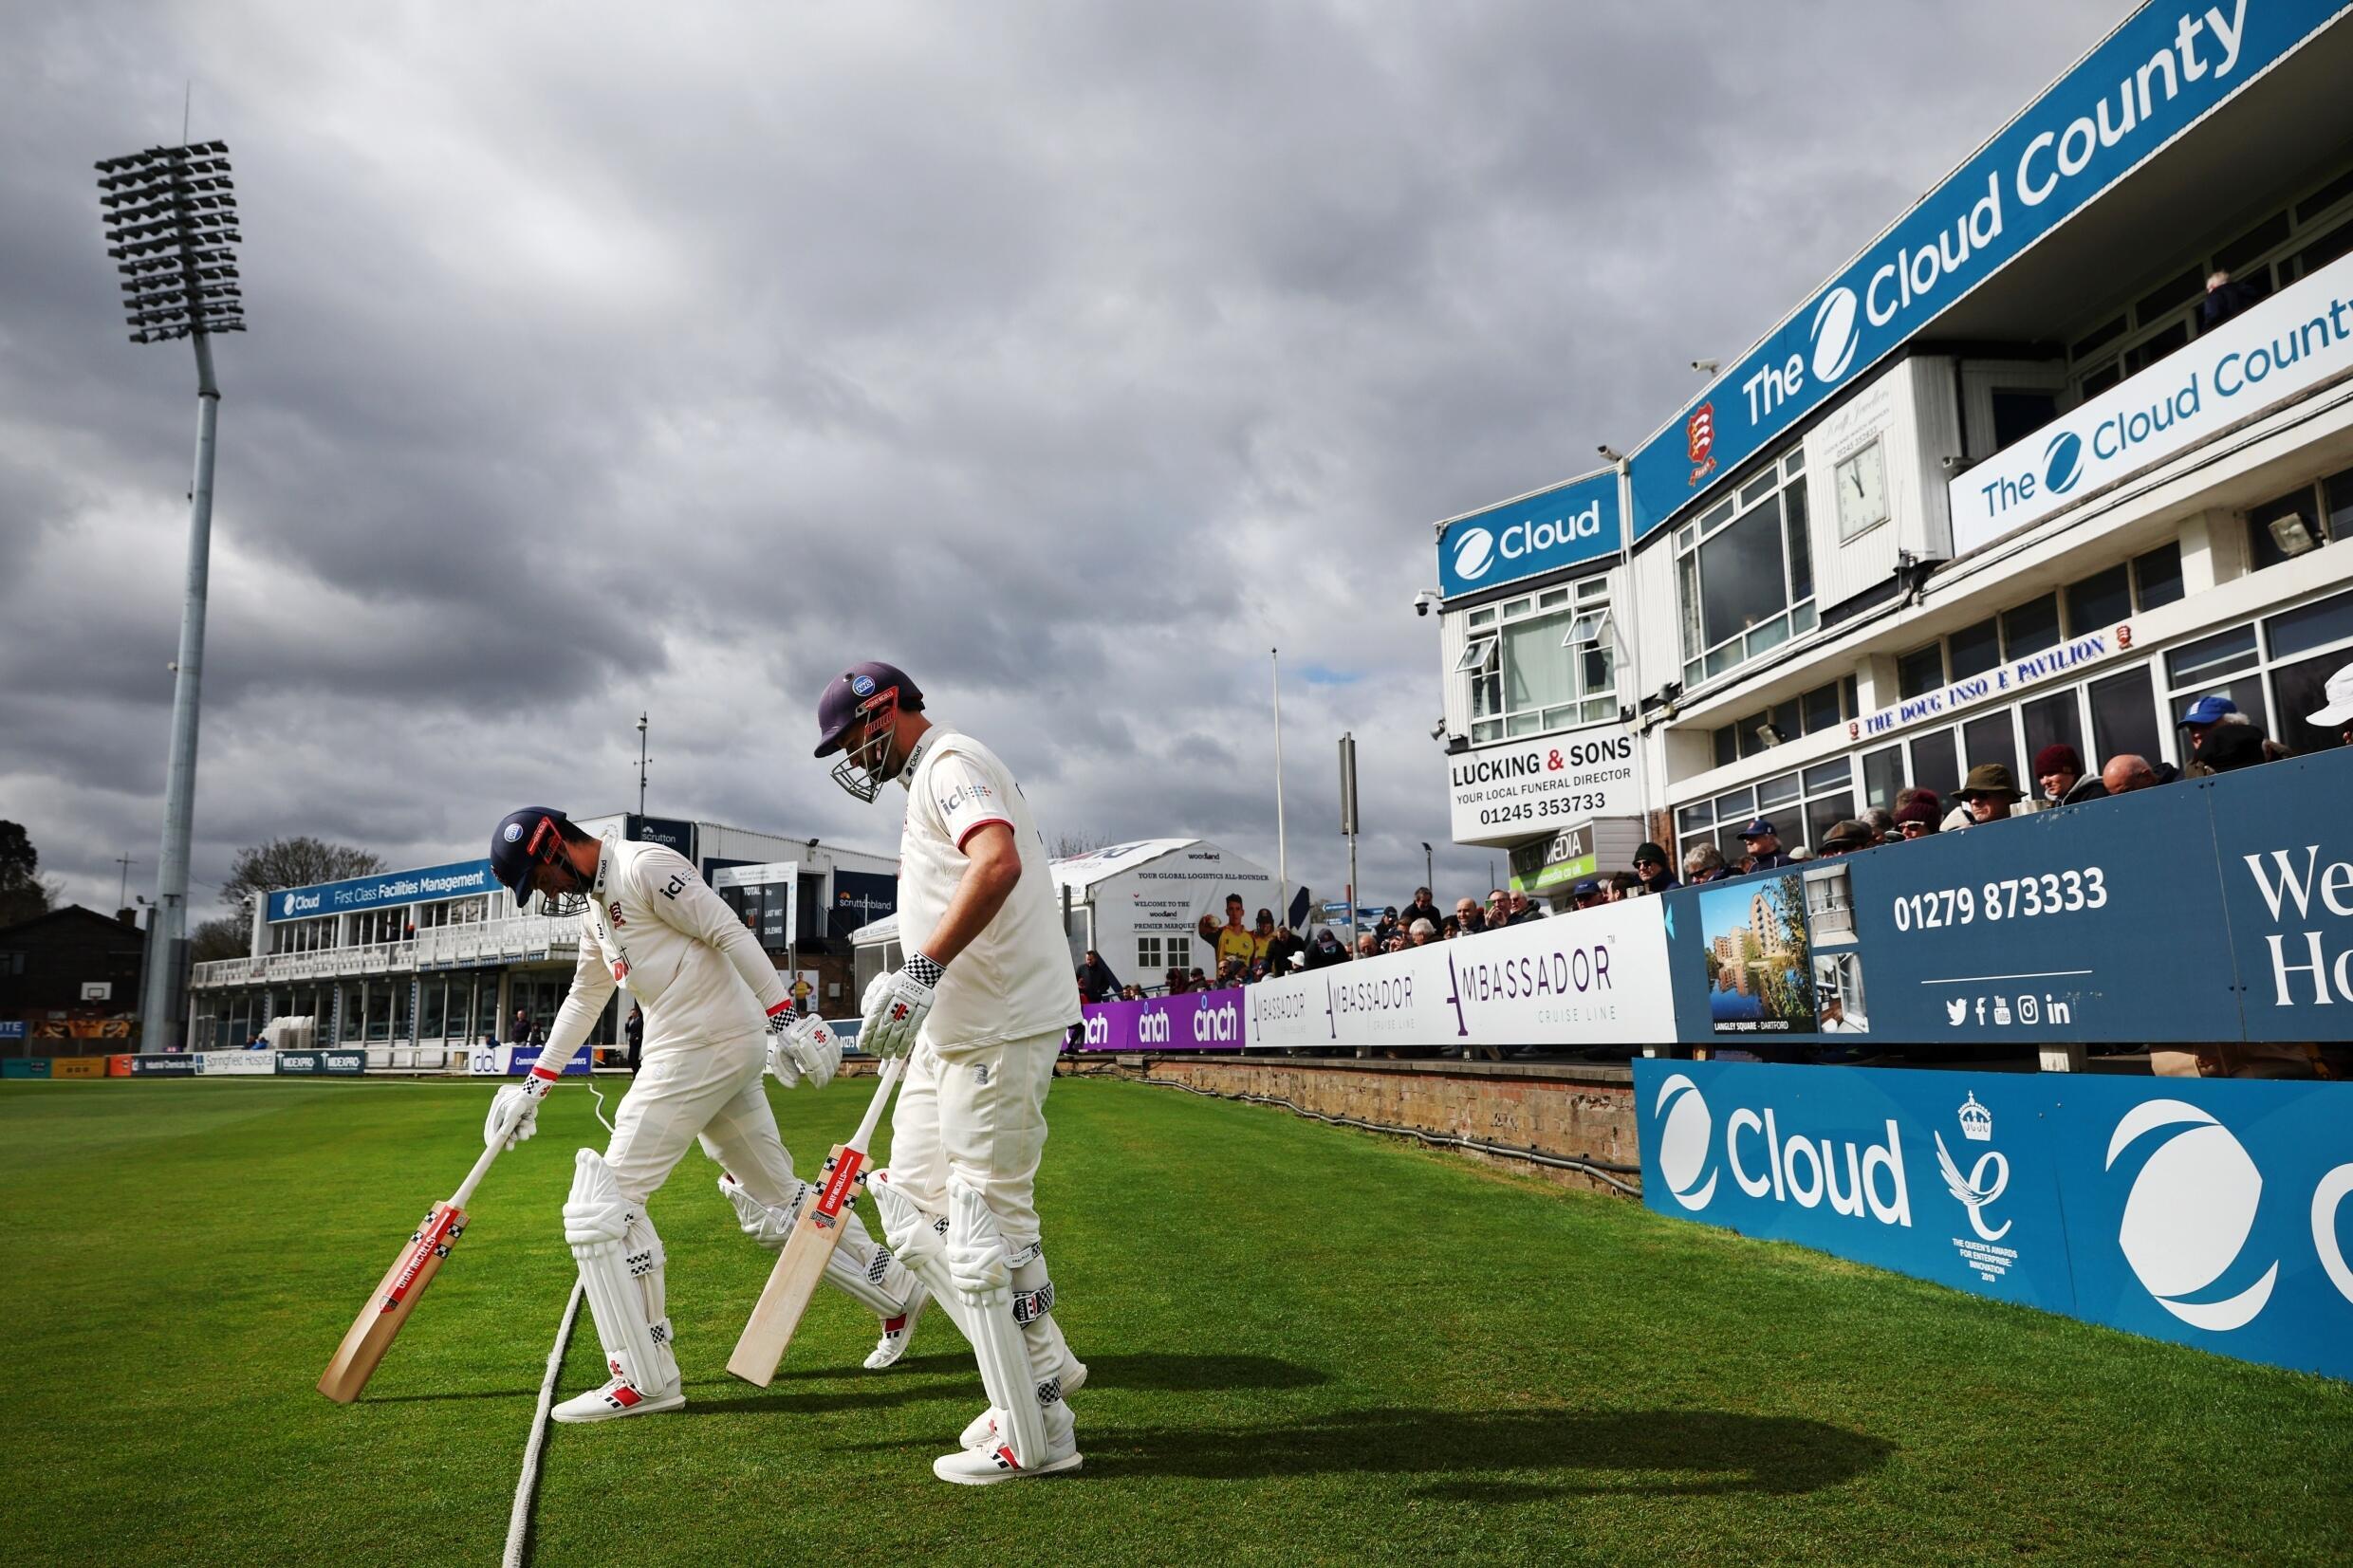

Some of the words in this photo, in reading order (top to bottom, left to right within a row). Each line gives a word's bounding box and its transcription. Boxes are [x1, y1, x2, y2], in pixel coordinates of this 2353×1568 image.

[1743, 353, 1803, 426] The
[1865, 171, 2003, 327] Cloud
[2016, 0, 2248, 207] County
[1981, 471, 2036, 517] The
[2093, 373, 2201, 461] Cloud
[2213, 298, 2353, 397] Count
[1499, 501, 1601, 561] Cloud
[856, 680, 873, 693] NHS
[1864, 711, 1894, 735] THE
[1900, 695, 1943, 723] DOUG
[2016, 636, 2105, 685] PAVILION
[909, 746, 922, 768] Cloud
[1453, 752, 1541, 787] LUCKING
[1547, 749, 1565, 771] &
[1570, 736, 1632, 766] SONS
[940, 784, 967, 817] icl
[1456, 791, 1483, 805] YOUR
[1486, 787, 1519, 802] LOCAL
[1521, 777, 1570, 795] FUNERAL
[1573, 767, 1632, 786] DIRECTOR
[1480, 802, 1533, 825] 01245
[1538, 792, 1605, 817] 353733
[641, 831, 676, 843] scrutton
[1543, 831, 1583, 866] MEDIA
[599, 859, 607, 879] Cloud
[1188, 852, 1220, 860] woodland
[295, 893, 321, 911] Cloud
[334, 889, 354, 905] First
[355, 888, 377, 902] Class
[379, 880, 418, 899] Facilities
[420, 870, 485, 894] Management
[659, 875, 686, 901] icl
[743, 885, 761, 896] TOTAL
[839, 897, 892, 911] scruttonbland
[1894, 887, 1975, 932] 01279
[1983, 866, 2108, 921] 873333
[1325, 969, 1414, 1040] AMBASSADOR
[1446, 947, 1612, 1037] AMBASSADOR
[1139, 1001, 1170, 1042] cinch
[1194, 994, 1237, 1042] cinch
[1538, 1008, 1579, 1024] CRUISE
[1586, 1005, 1617, 1022] LINE
[1736, 1022, 1757, 1032] SQUARE
[1760, 1021, 1789, 1030] DARTFORD
[206, 1054, 243, 1069] Springfield
[245, 1053, 273, 1067] Hospital
[1727, 1107, 1913, 1227] Cloud
[1952, 1237, 1965, 1247] THE
[1964, 1240, 1991, 1253] QUEEN'S
[1991, 1245, 2018, 1259] AWARDS
[1959, 1248, 1973, 1259] FOR
[1969, 1260, 2006, 1276] INNOVATION
